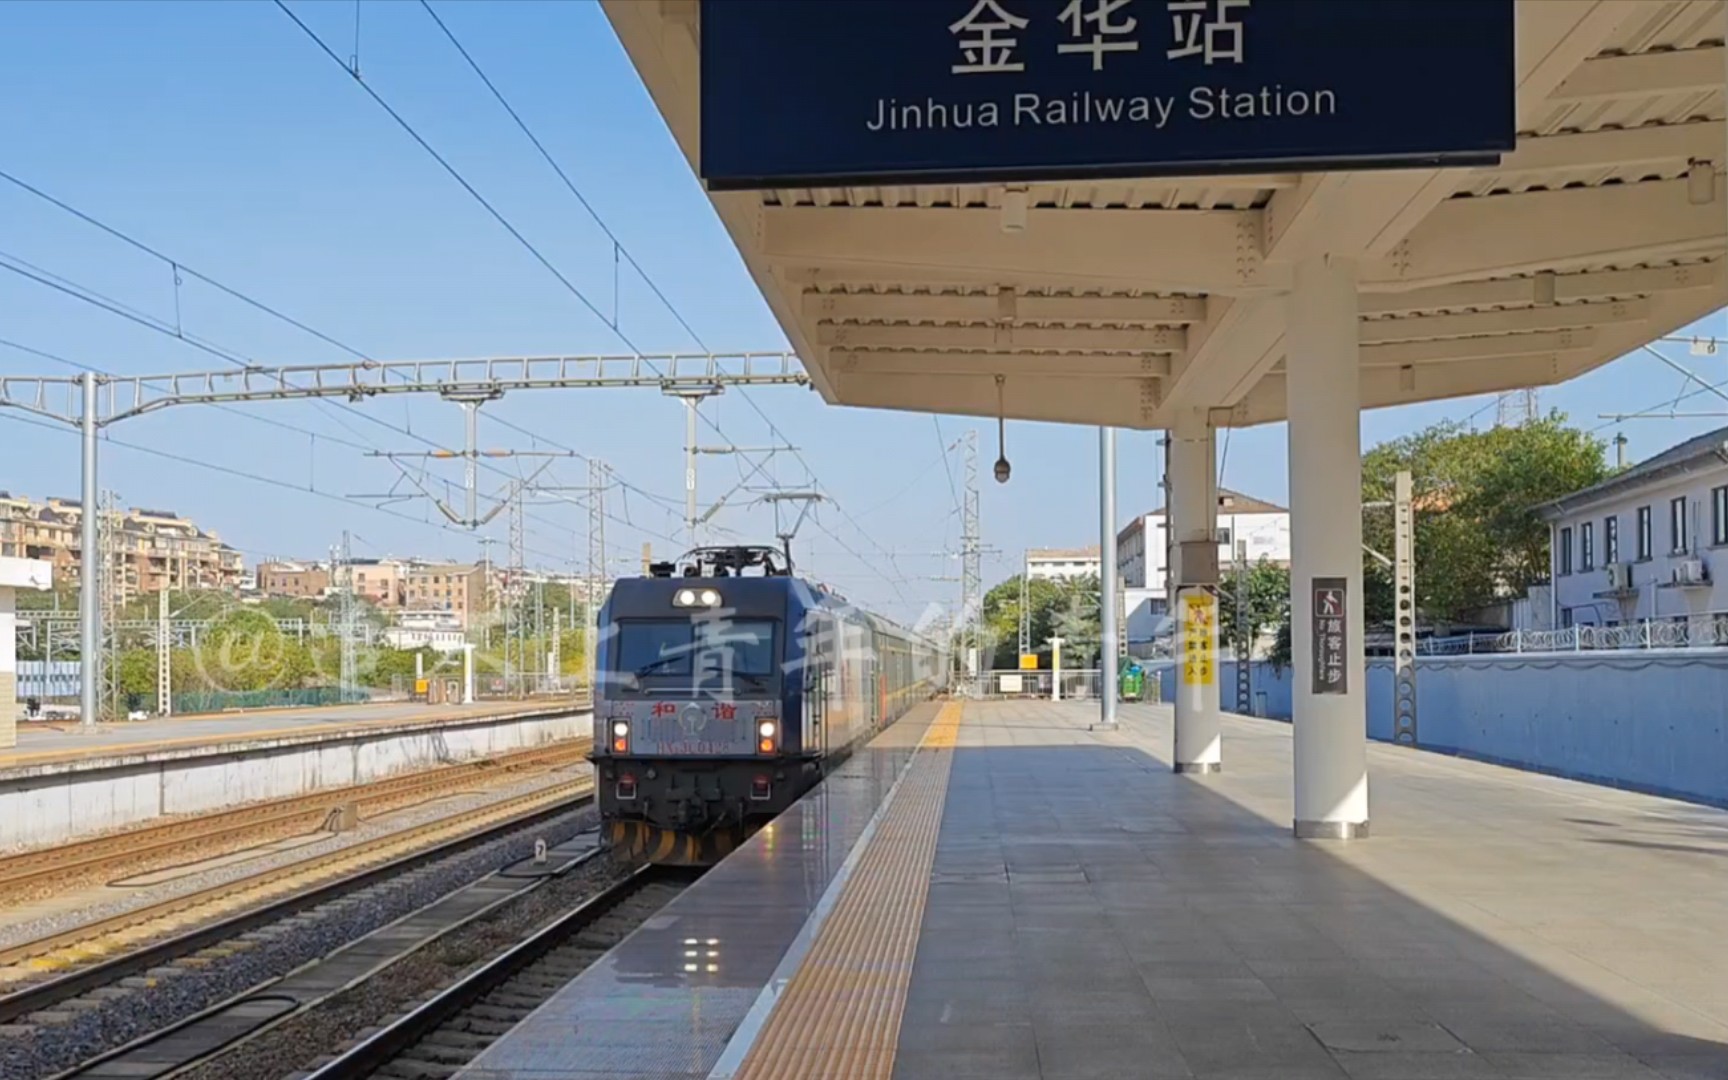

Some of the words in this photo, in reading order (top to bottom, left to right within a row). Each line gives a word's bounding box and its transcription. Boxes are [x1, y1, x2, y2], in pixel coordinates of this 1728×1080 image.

[948, 0, 1250, 73] 金华站
[866, 97, 999, 131] Jinhua
[1013, 91, 1175, 128] Railway
[1188, 85, 1336, 119] Station
[1327, 618, 1342, 684] 旅客止步
